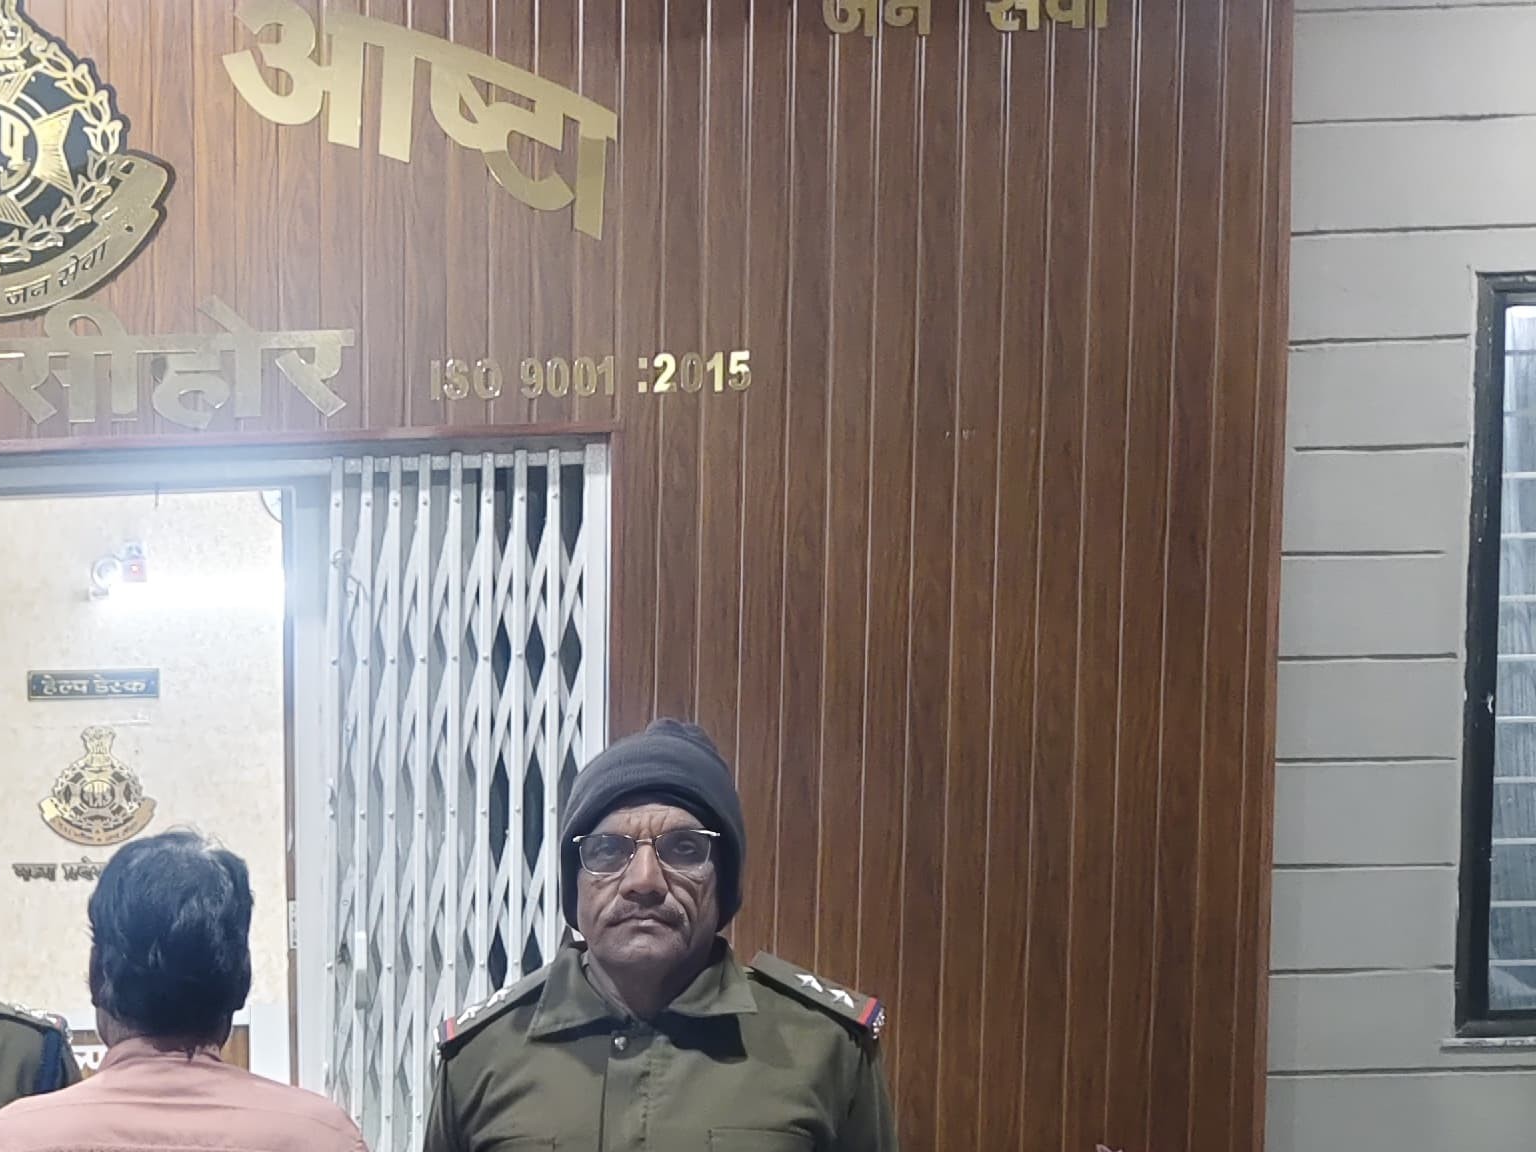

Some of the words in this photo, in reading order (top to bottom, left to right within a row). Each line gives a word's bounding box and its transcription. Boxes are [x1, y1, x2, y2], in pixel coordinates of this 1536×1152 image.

[222, 0, 618, 240] आष्टा
[430, 356, 504, 400] ISO
[520, 355, 614, 399] 9001
[637, 350, 752, 393] :2015
